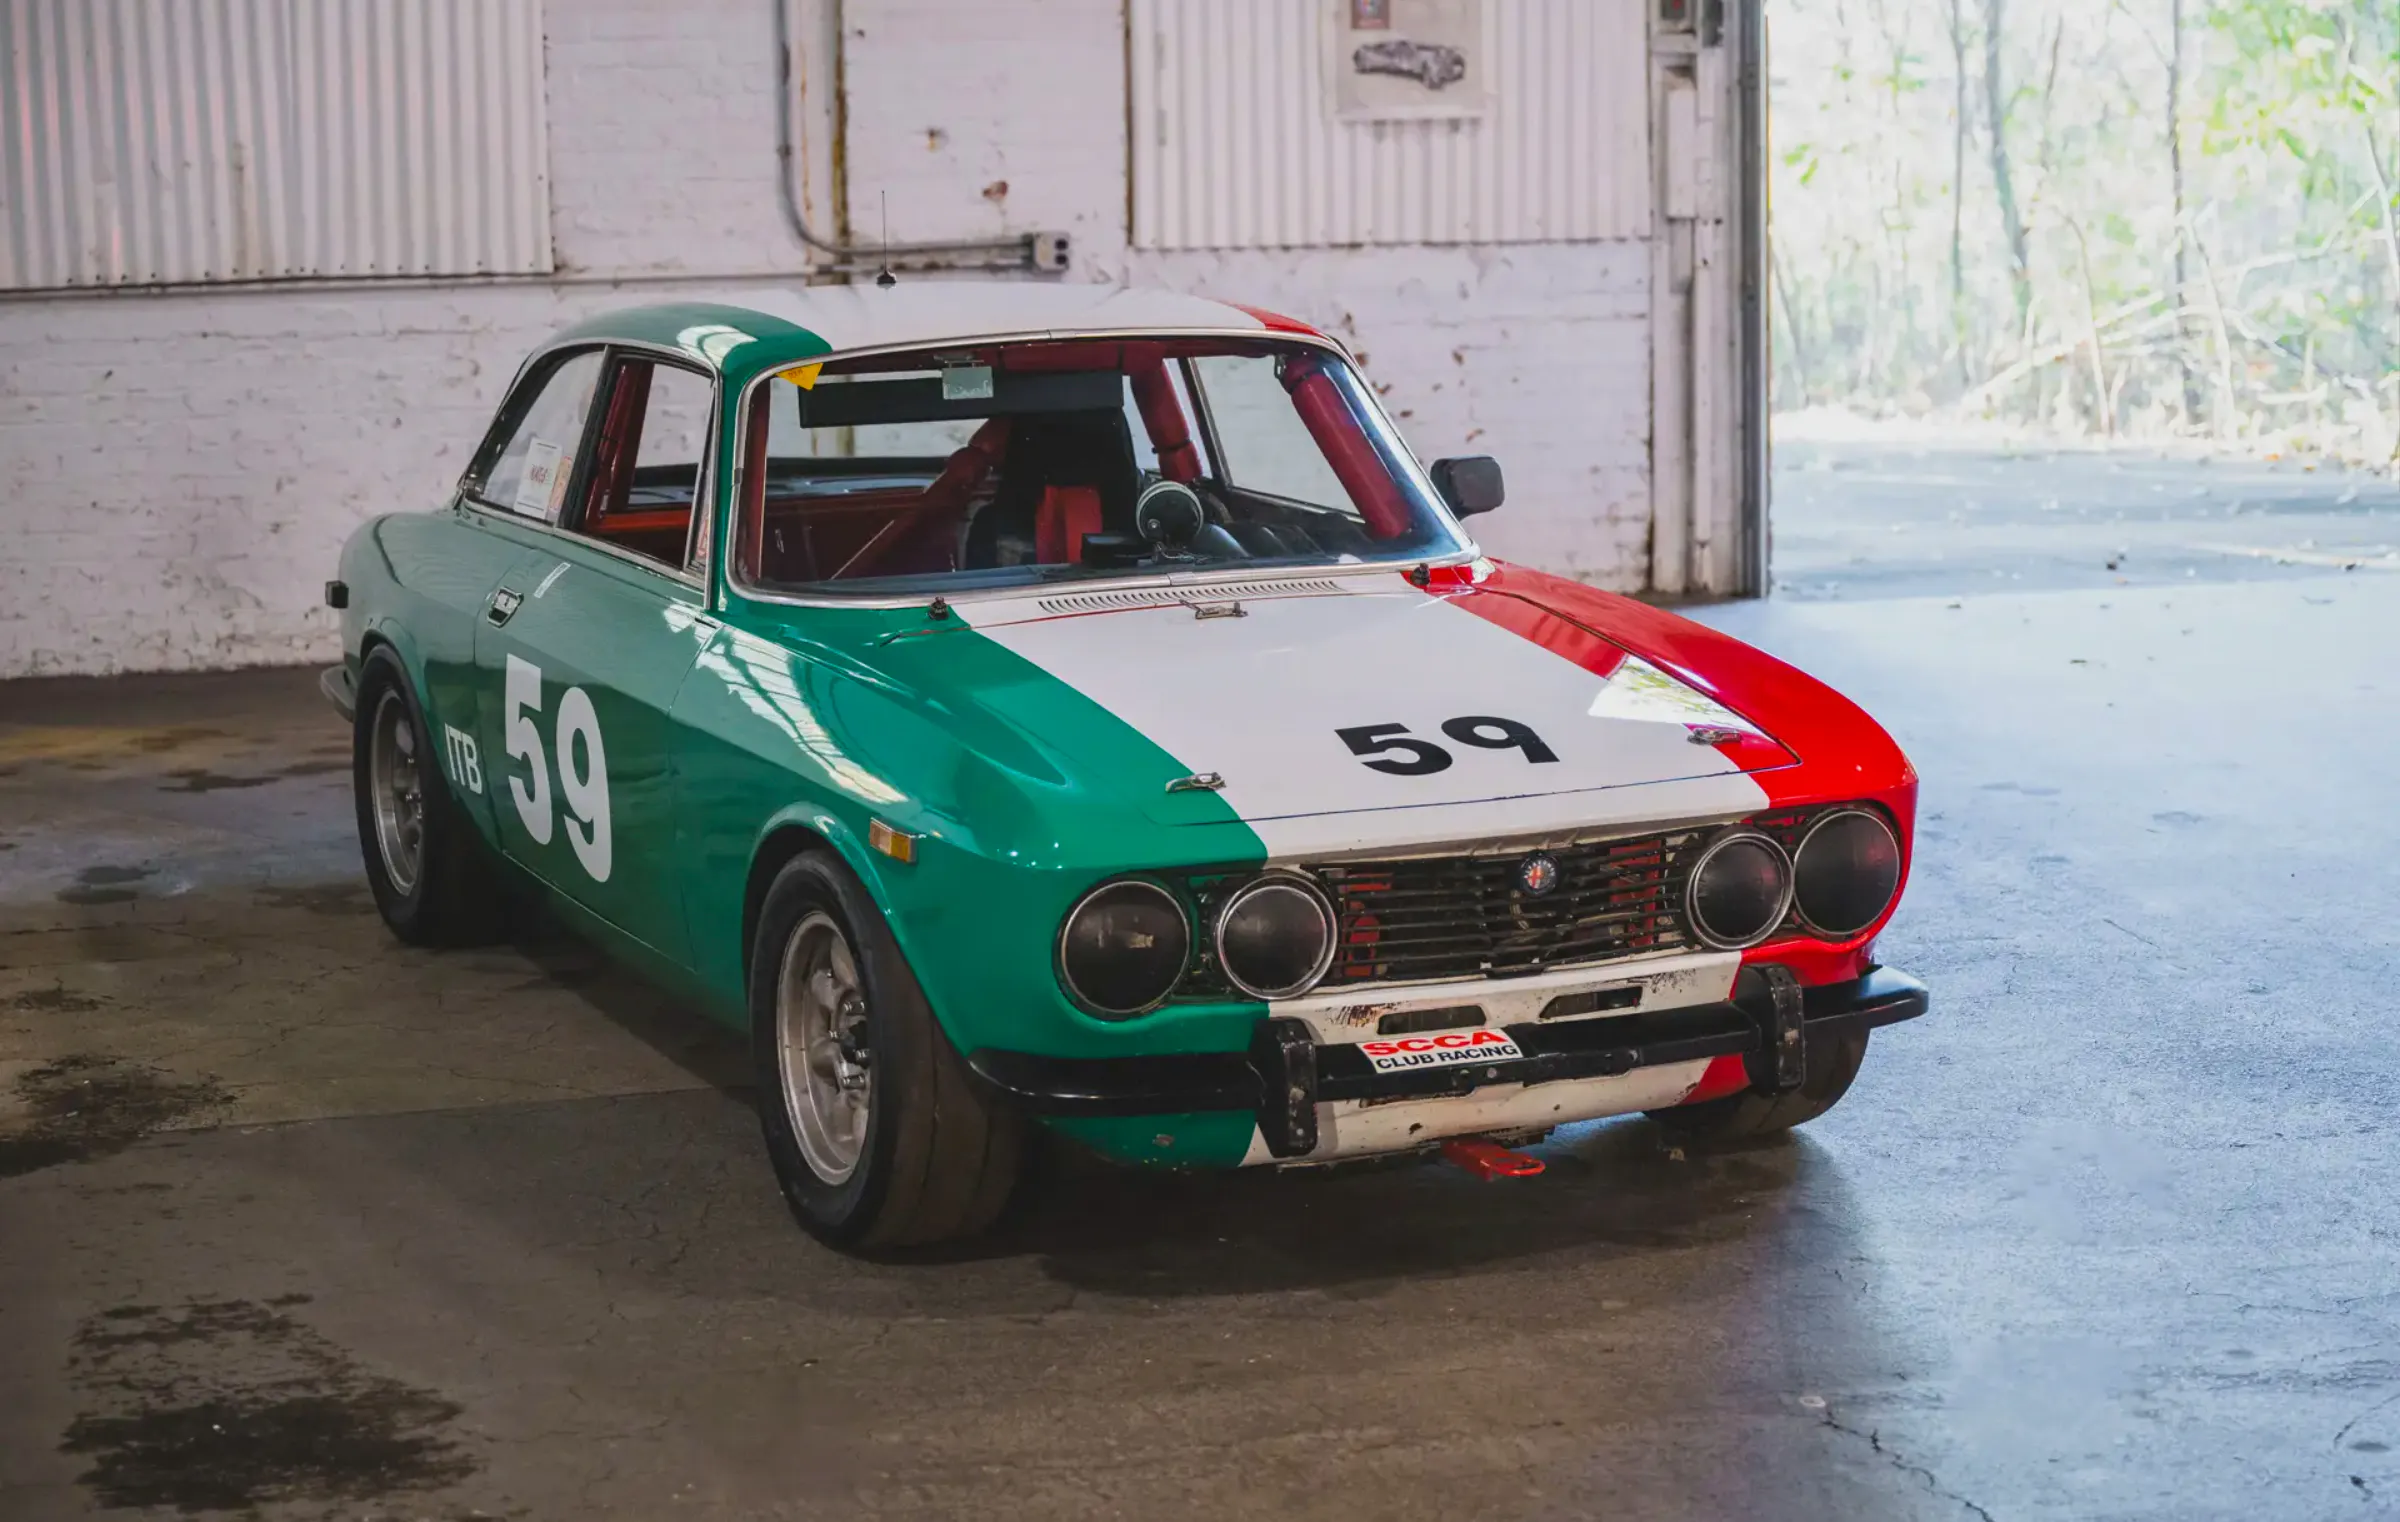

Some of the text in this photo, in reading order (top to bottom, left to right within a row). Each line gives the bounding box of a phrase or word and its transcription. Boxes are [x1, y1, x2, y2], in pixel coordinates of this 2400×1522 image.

[444, 723, 483, 794] ITB
[506, 653, 612, 883] 59
[1334, 715, 1561, 776] 59
[1362, 1031, 1509, 1056] SCCA
[1375, 1045, 1519, 1069] CLUB RACING
